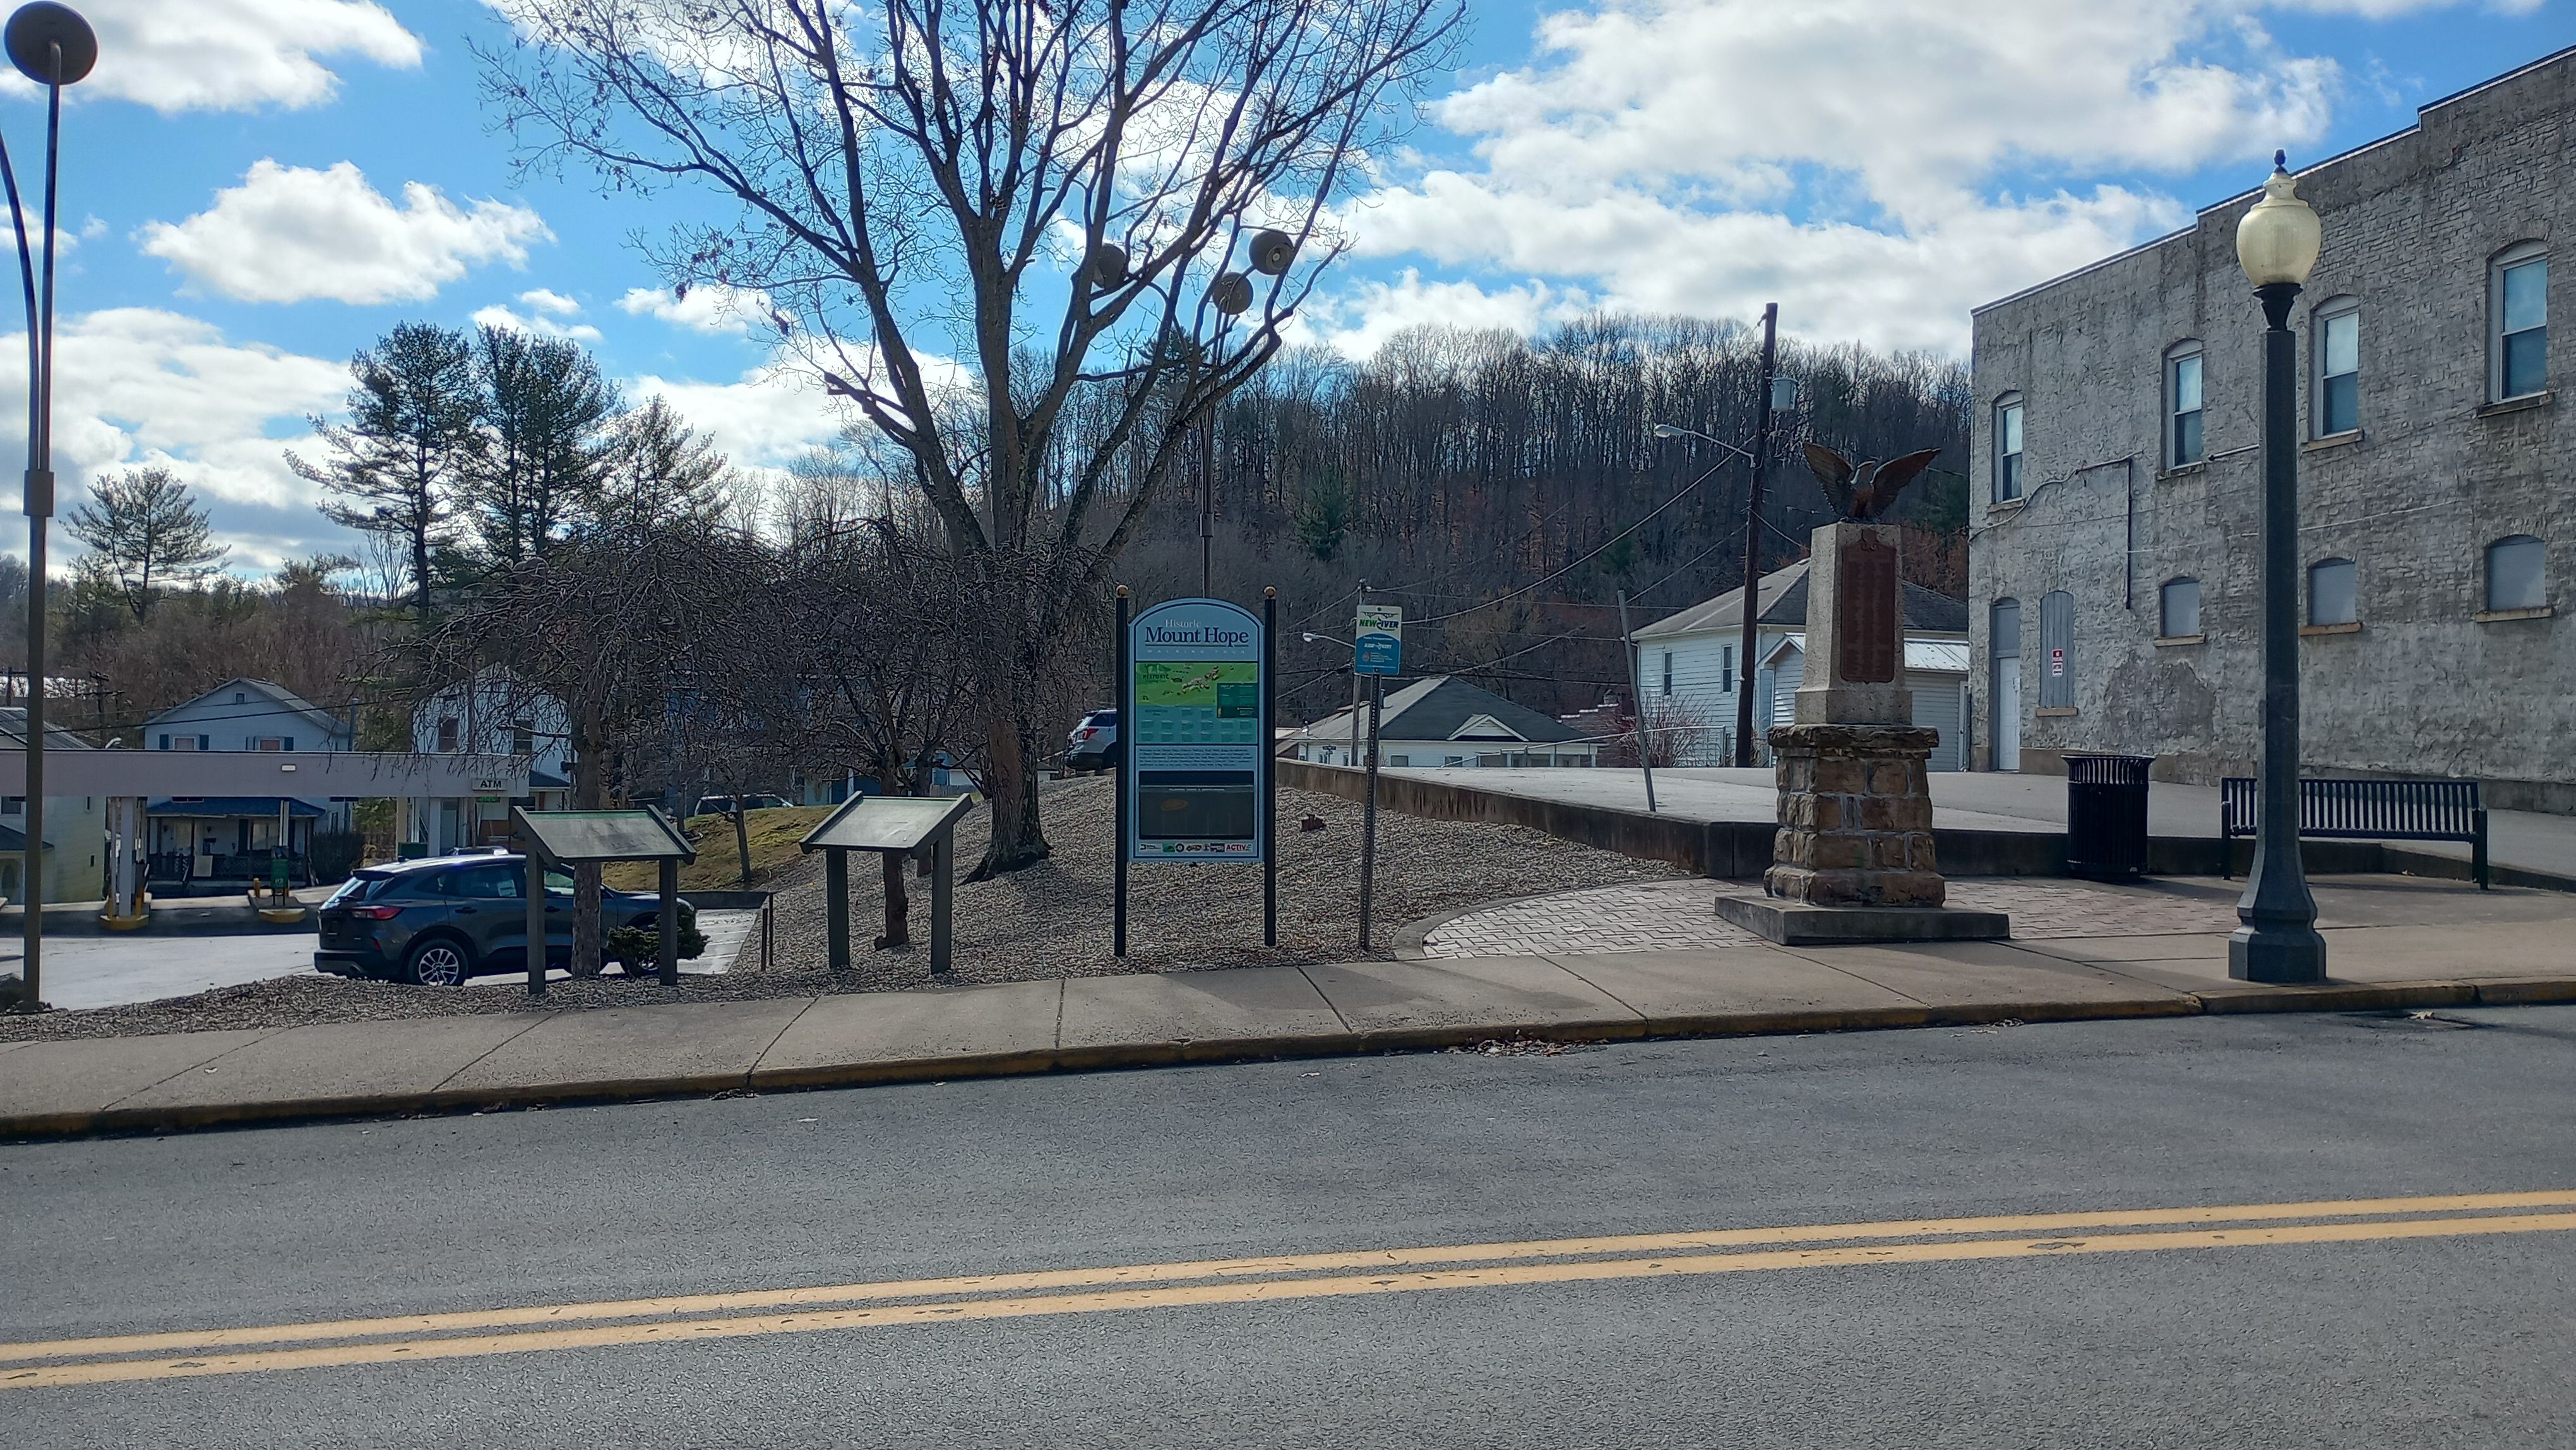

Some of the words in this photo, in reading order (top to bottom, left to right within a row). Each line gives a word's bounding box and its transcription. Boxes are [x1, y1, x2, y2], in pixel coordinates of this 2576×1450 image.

[1165, 619, 1202, 628] Historic
[1359, 619, 1377, 627] NEW
[1145, 626, 1201, 643] Mount
[1204, 627, 1249, 647] Hope
[480, 780, 501, 788] ATM
